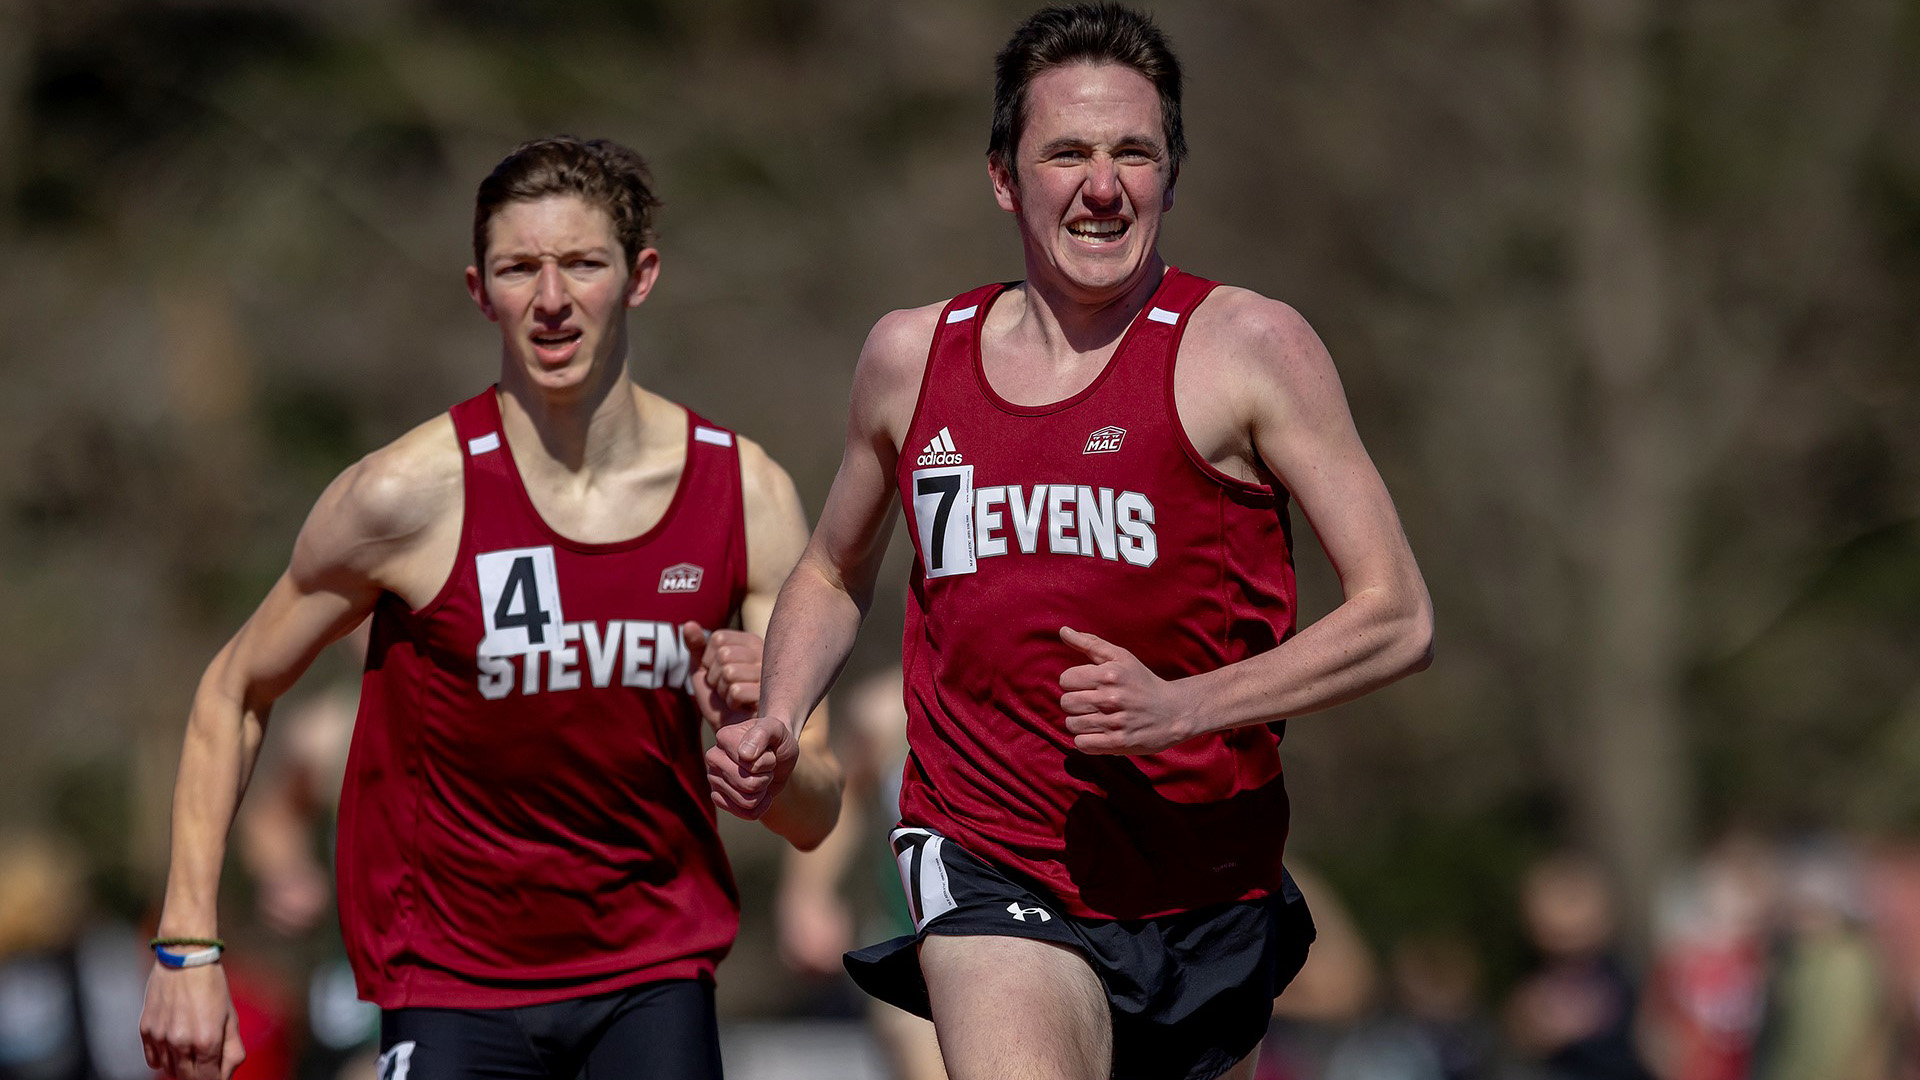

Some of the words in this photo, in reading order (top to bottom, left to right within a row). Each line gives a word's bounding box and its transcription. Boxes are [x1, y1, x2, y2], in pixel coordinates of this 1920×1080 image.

[916, 451, 963, 466] adidas
[1087, 438, 1121, 451] MAC
[916, 474, 961, 569] 7
[974, 484, 1159, 568] EVENS
[493, 556, 550, 645] 4
[662, 577, 699, 590] MAC
[477, 619, 711, 701] STEVEN
[894, 832, 932, 925] 7
